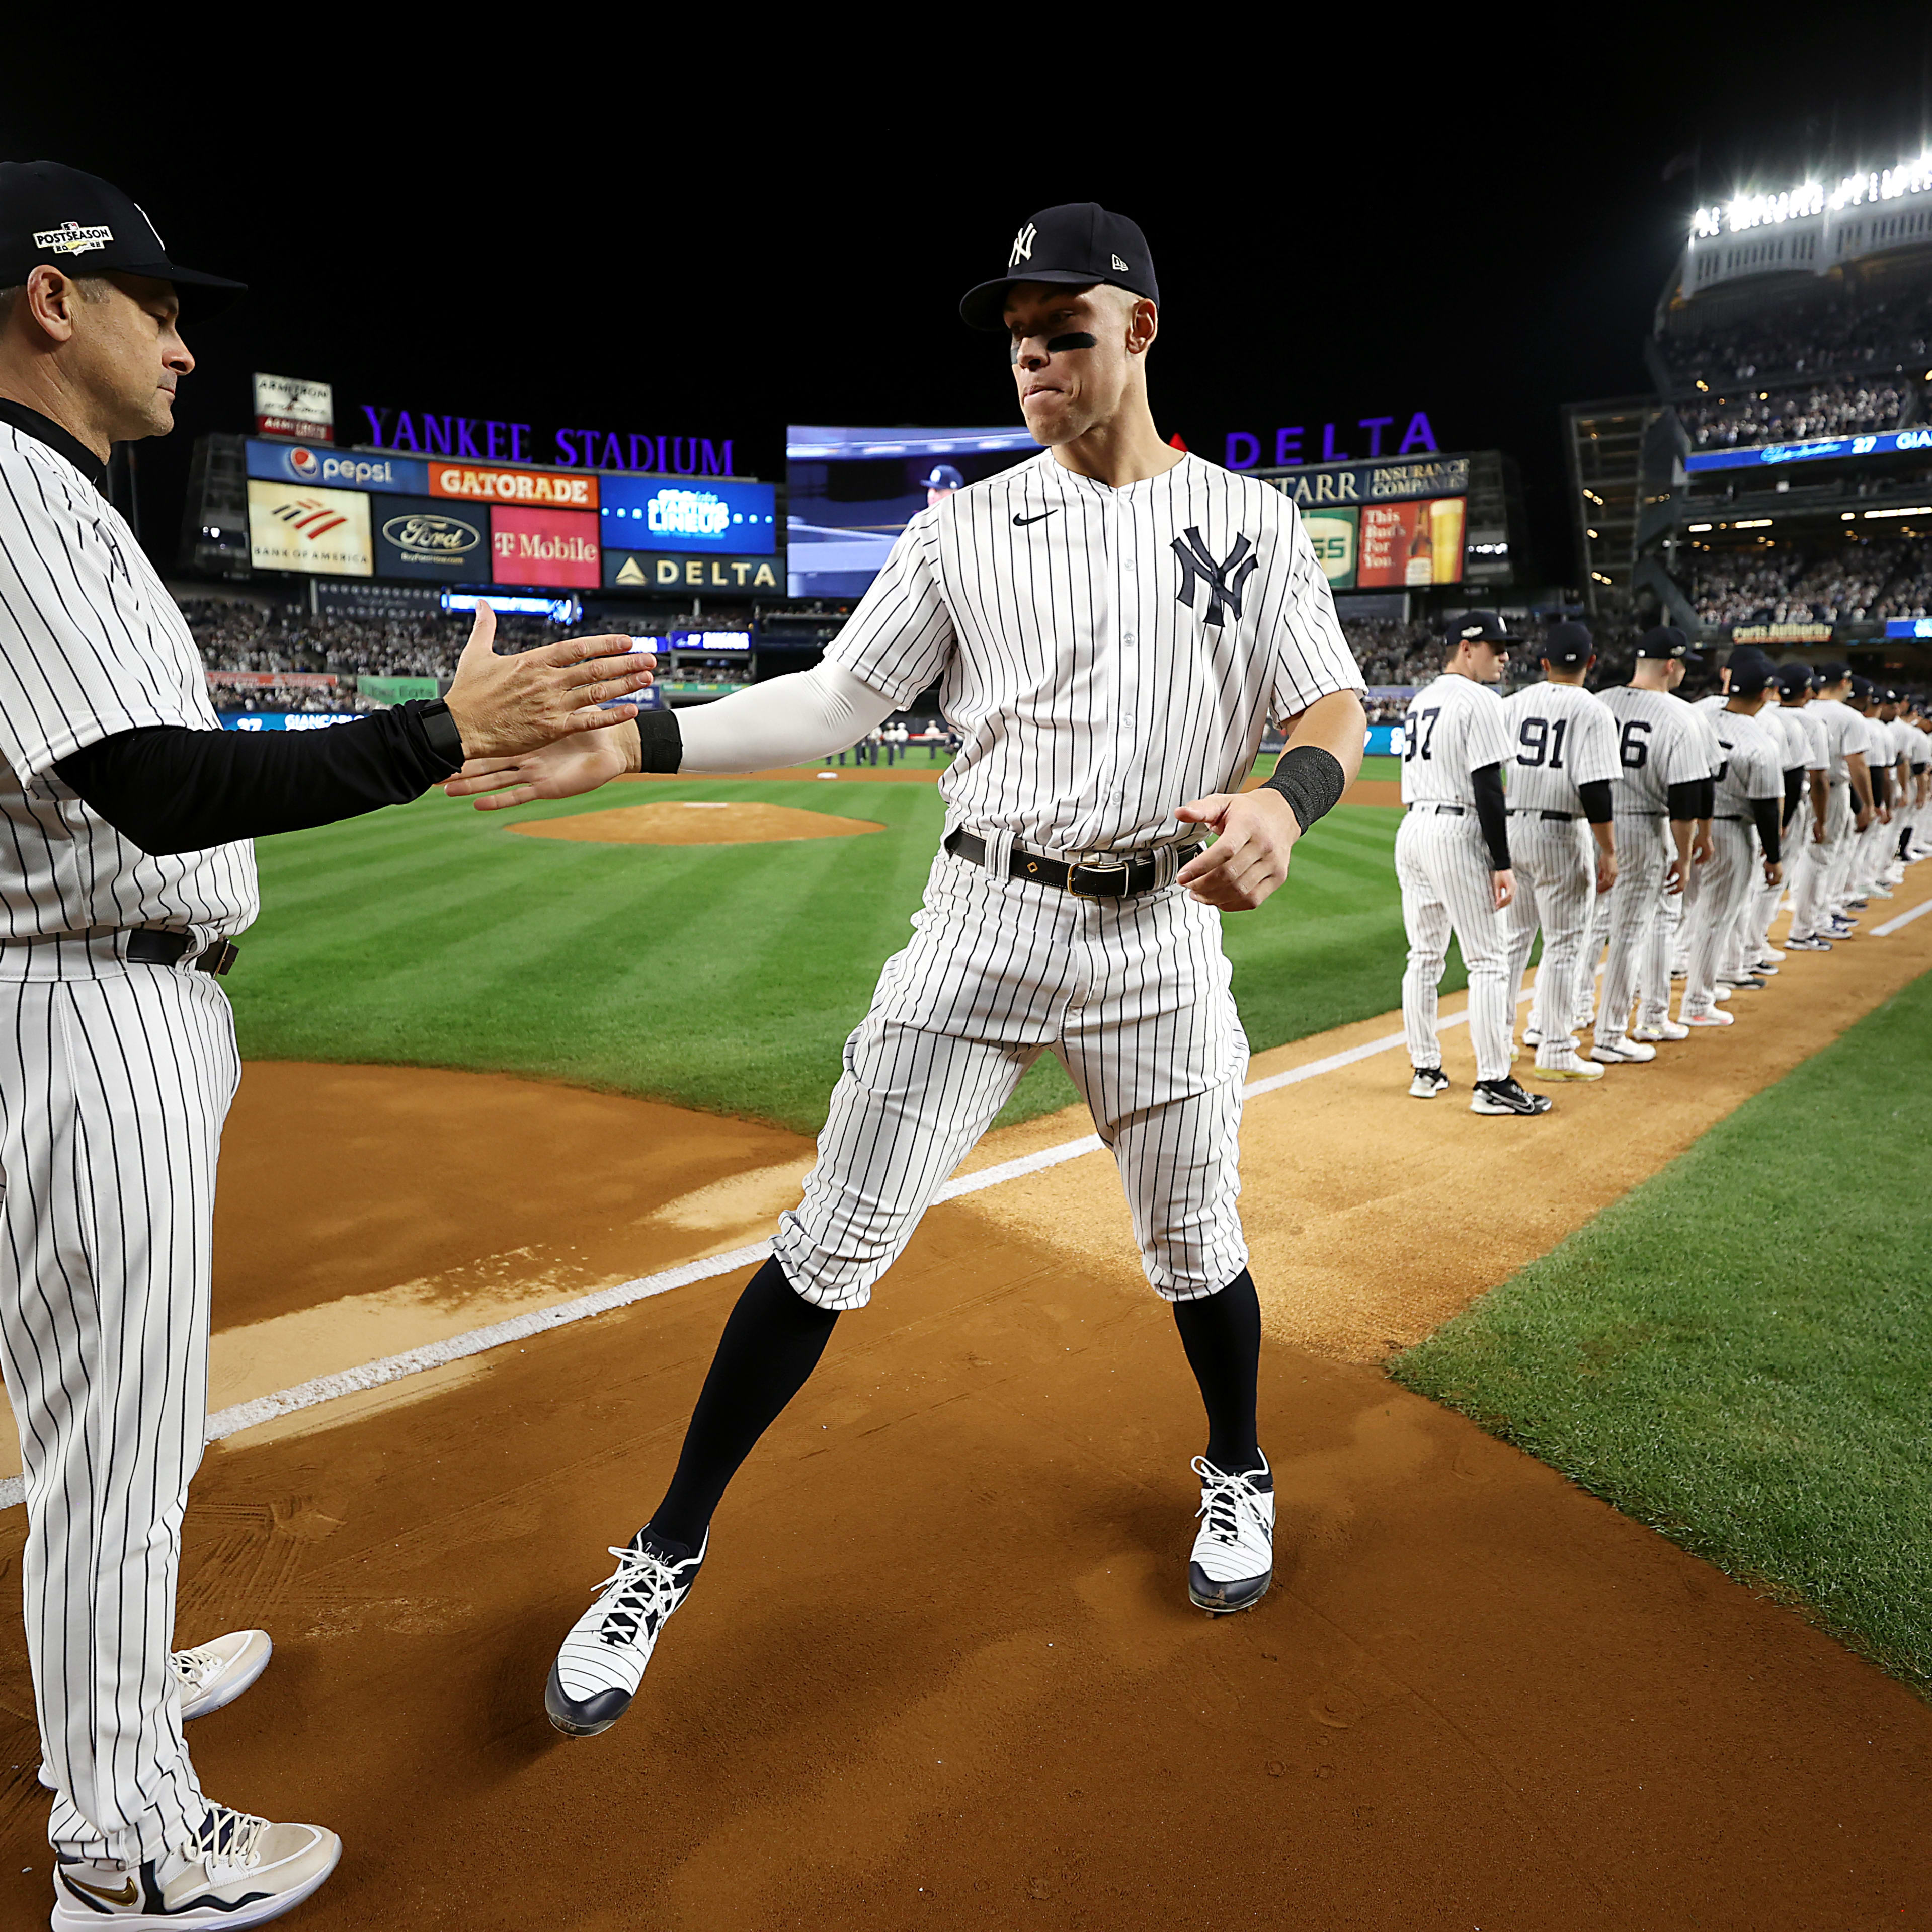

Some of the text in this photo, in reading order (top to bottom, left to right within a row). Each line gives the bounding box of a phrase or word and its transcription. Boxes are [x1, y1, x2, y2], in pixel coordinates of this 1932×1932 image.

[37, 229, 109, 245] POSTSEASON
[1008, 222, 1037, 268] NY
[361, 405, 533, 463] YANKEE
[555, 428, 734, 476] STADIUM
[1225, 411, 1437, 470] DELTA
[1852, 436, 1877, 454] 27
[323, 458, 394, 485] pepsi
[1373, 459, 1470, 482] INSURANCE
[440, 469, 589, 503] GATORADE
[1267, 471, 1360, 502] TARR
[1371, 473, 1469, 498] COMPANIES
[648, 513, 730, 533] LINEUP
[1364, 508, 1400, 524] This
[400, 518, 463, 548] Ford
[1364, 523, 1406, 538] Bud's
[254, 547, 367, 563] BANK OF AMERICA
[1364, 540, 1391, 554] For
[657, 559, 777, 587] DELTA
[1170, 526, 1259, 627] NY
[1516, 718, 1567, 768] 91
[1615, 716, 1652, 768] 6
